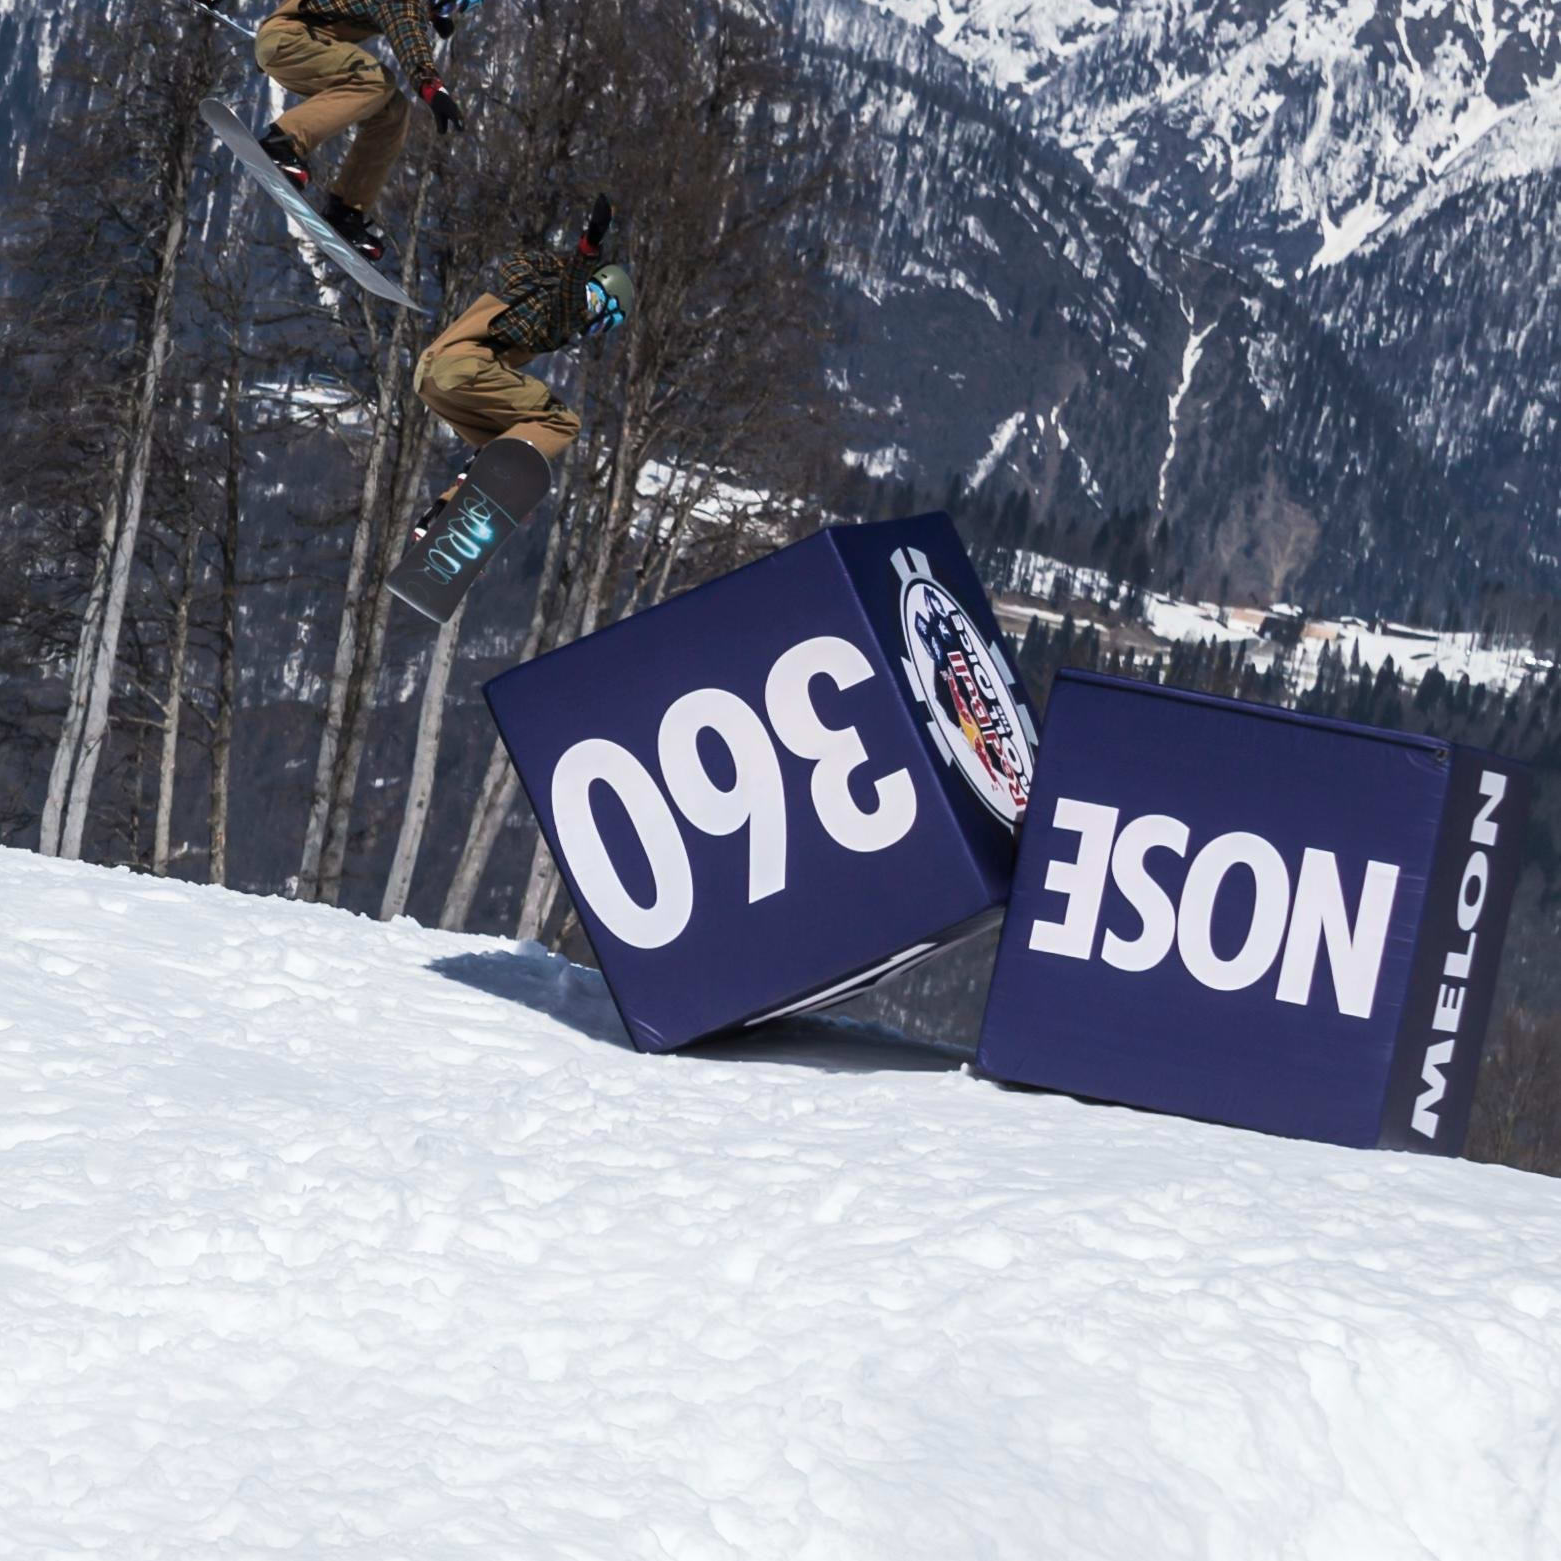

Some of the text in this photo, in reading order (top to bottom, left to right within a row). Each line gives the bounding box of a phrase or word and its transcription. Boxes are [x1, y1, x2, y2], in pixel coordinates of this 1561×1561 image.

[550, 635, 918, 950] 360
[947, 651, 1028, 807] Red Bull
[1027, 797, 1401, 1020] NOSE
[1410, 769, 1508, 1140] MELON
